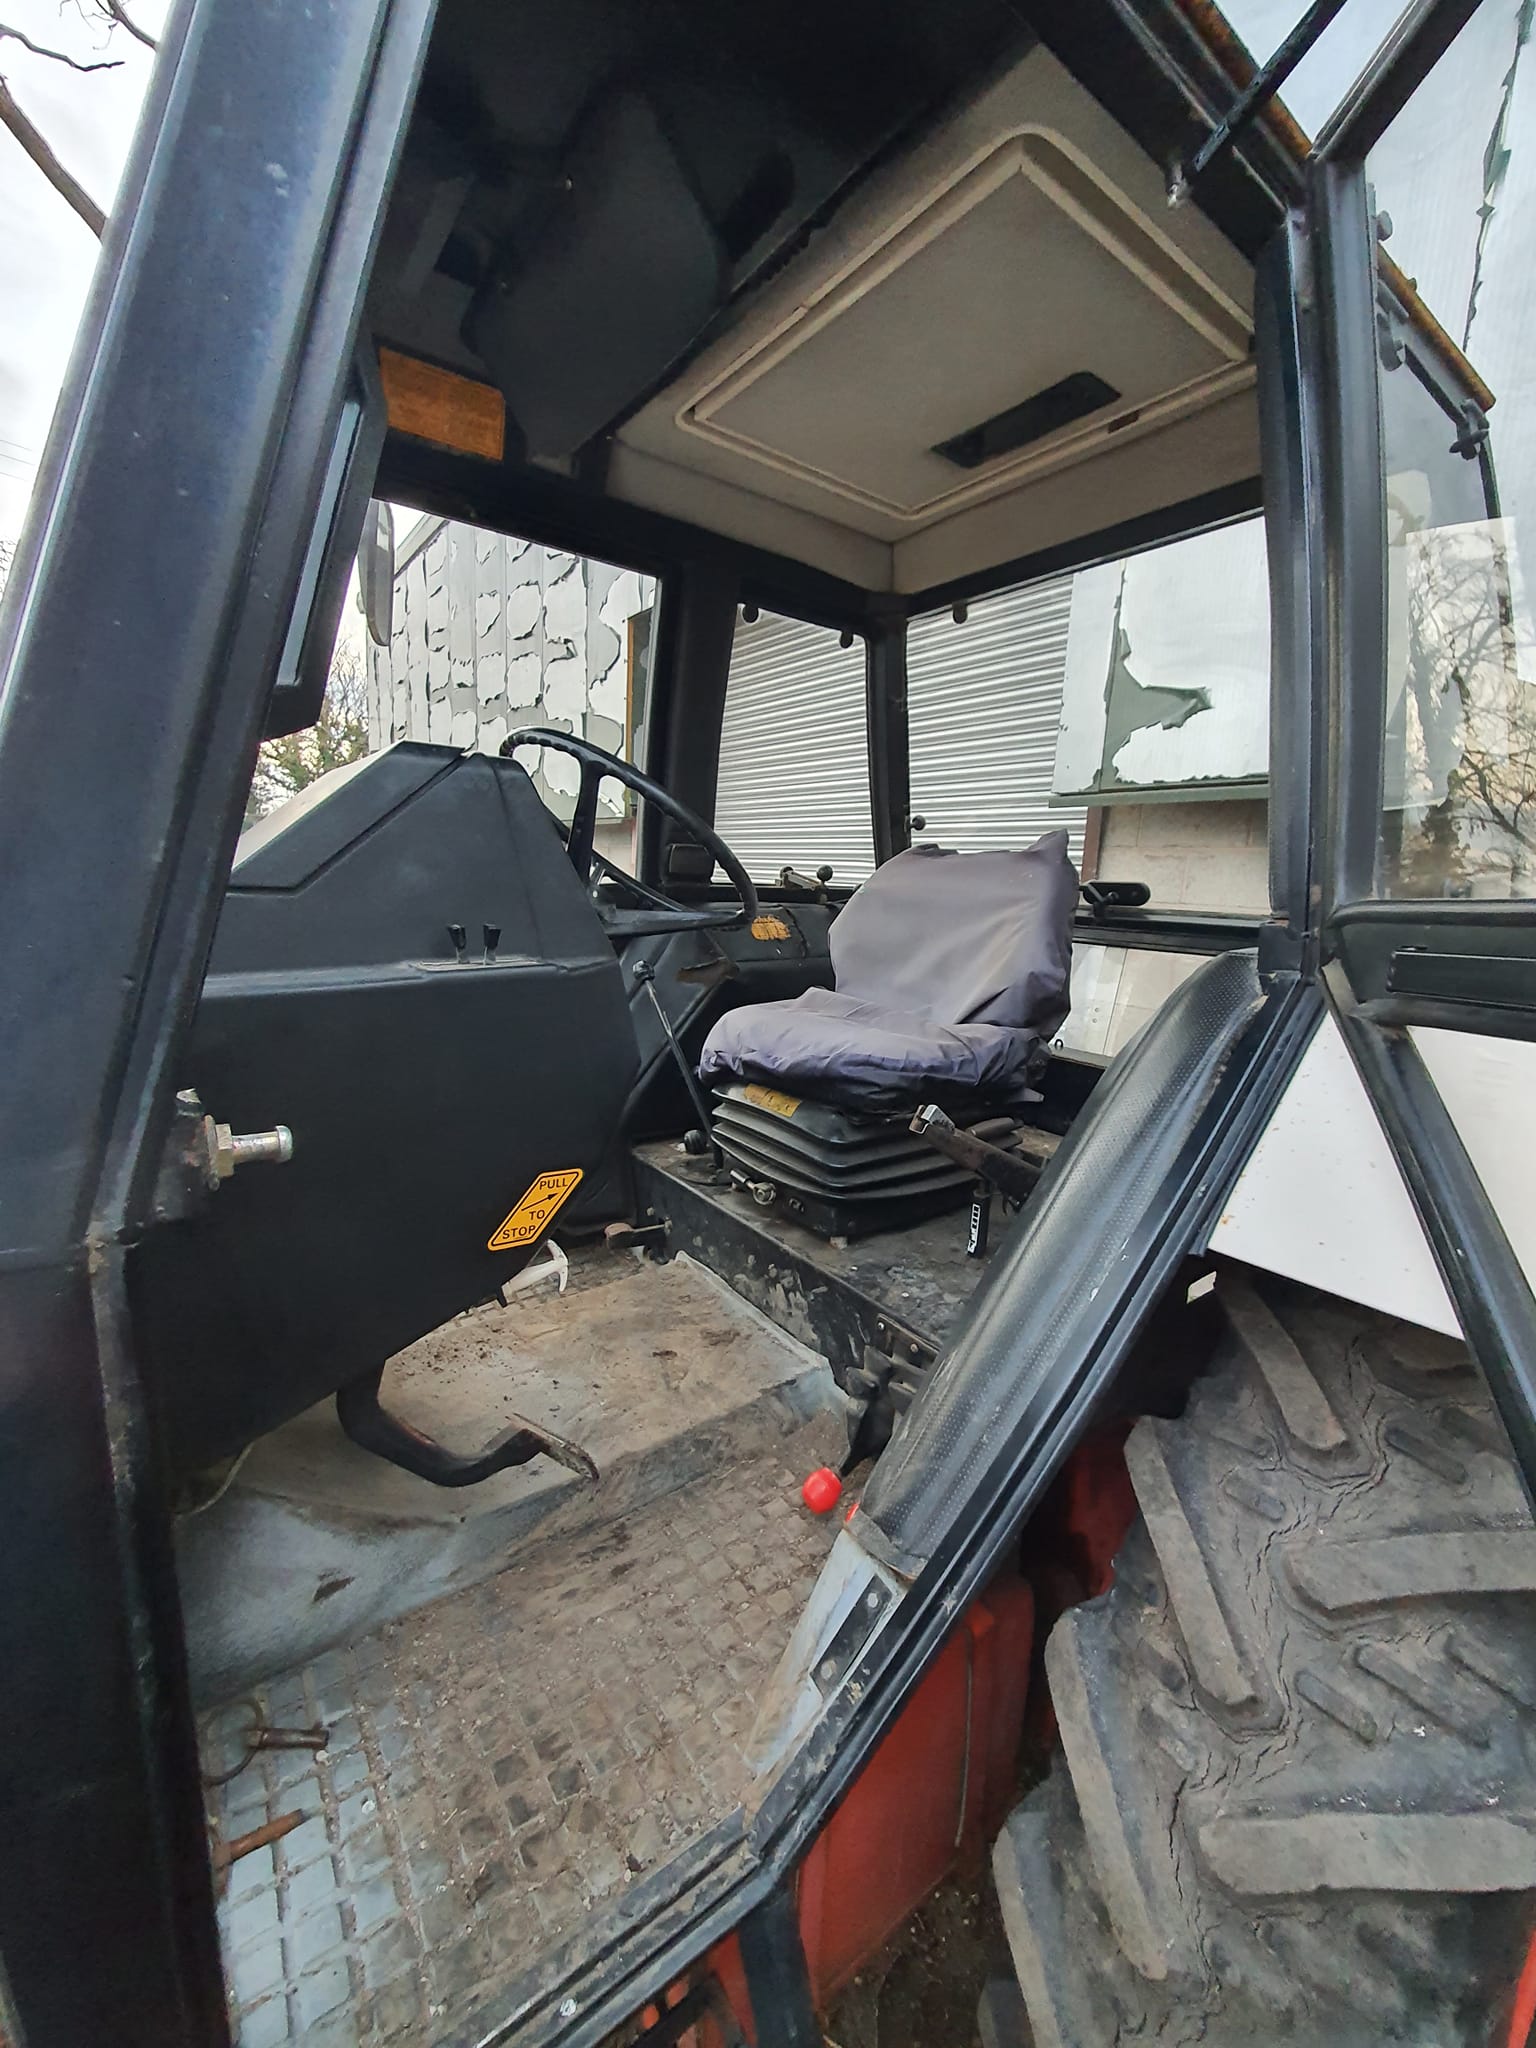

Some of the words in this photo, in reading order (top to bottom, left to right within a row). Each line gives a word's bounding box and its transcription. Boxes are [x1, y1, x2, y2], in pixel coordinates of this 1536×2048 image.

[539, 1178, 568, 1190] PULL
[529, 1209, 545, 1220] TO
[502, 1225, 536, 1239] STOP
